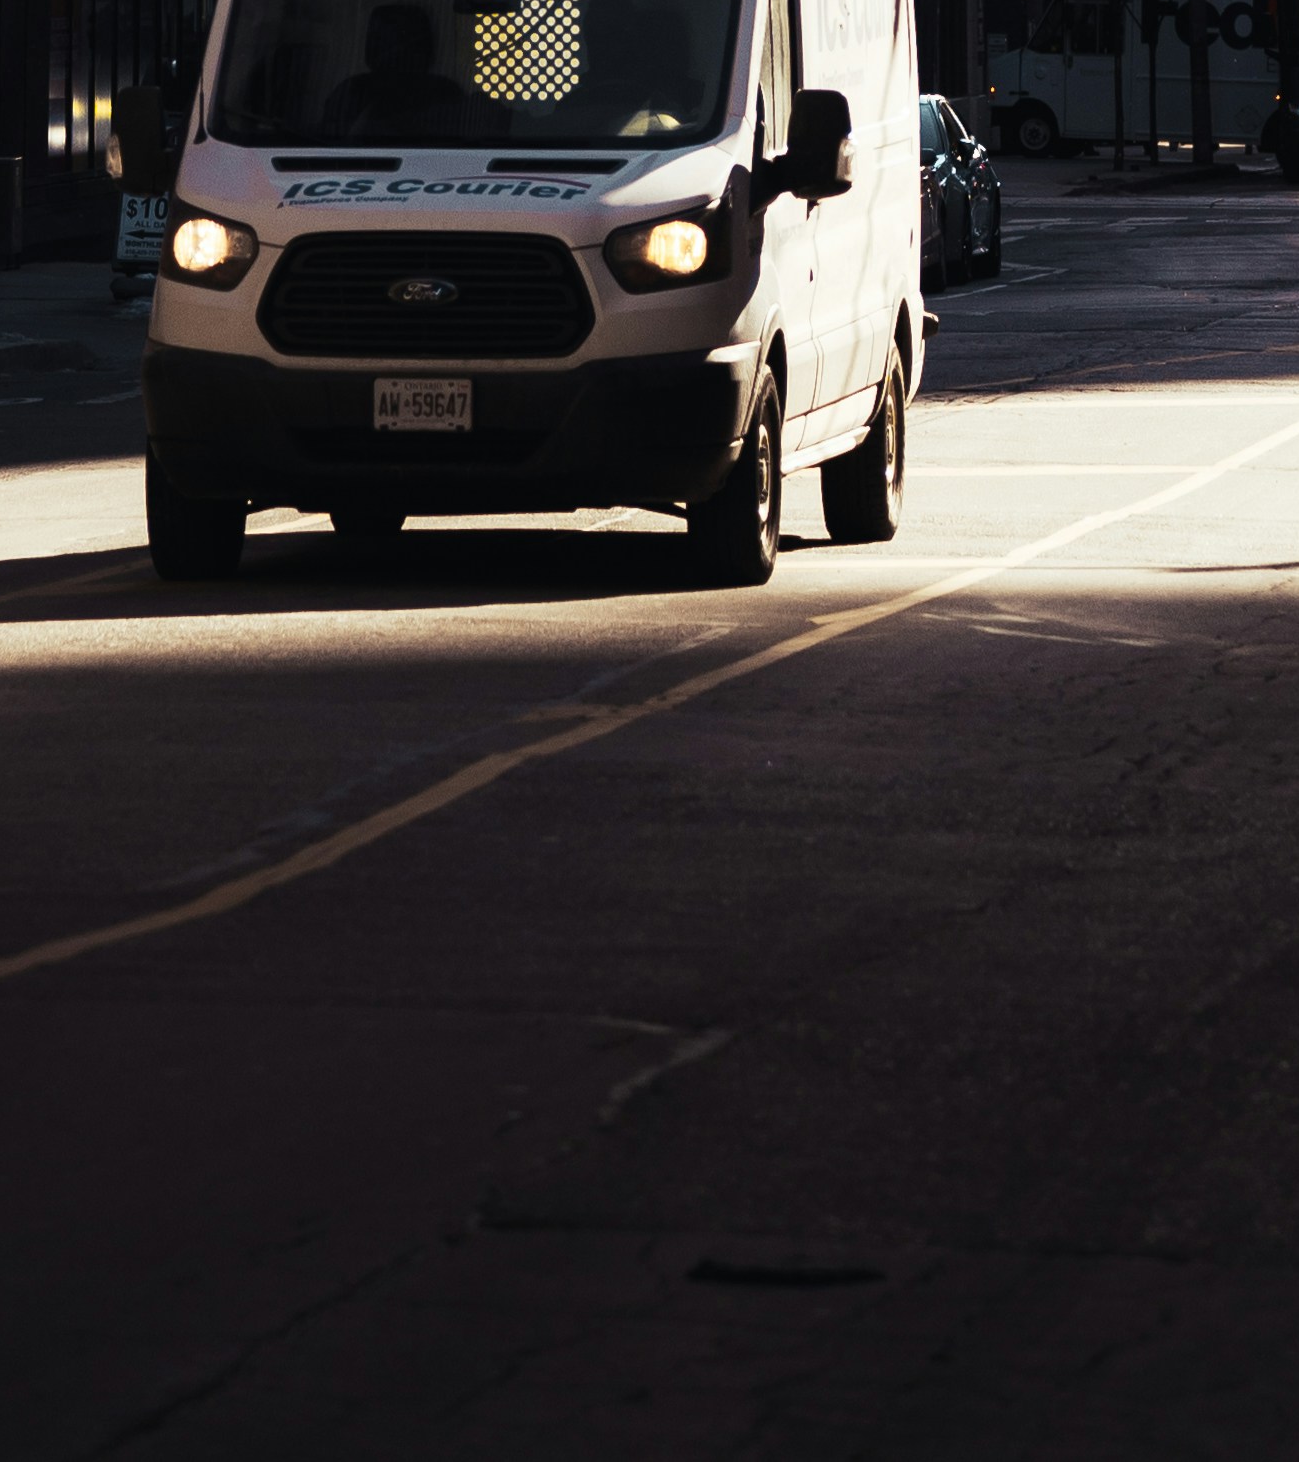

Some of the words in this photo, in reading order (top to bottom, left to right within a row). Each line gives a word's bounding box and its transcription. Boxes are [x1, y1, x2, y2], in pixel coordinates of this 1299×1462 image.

[283, 179, 376, 199] ICS
[386, 178, 590, 201] Courier
[354, 194, 410, 204] Company
[126, 197, 168, 221] $10
[135, 221, 151, 229] ALL
[403, 283, 442, 301] Ford
[404, 382, 443, 391] ONTARIO
[379, 392, 400, 418] AW
[412, 392, 468, 418] 59647
